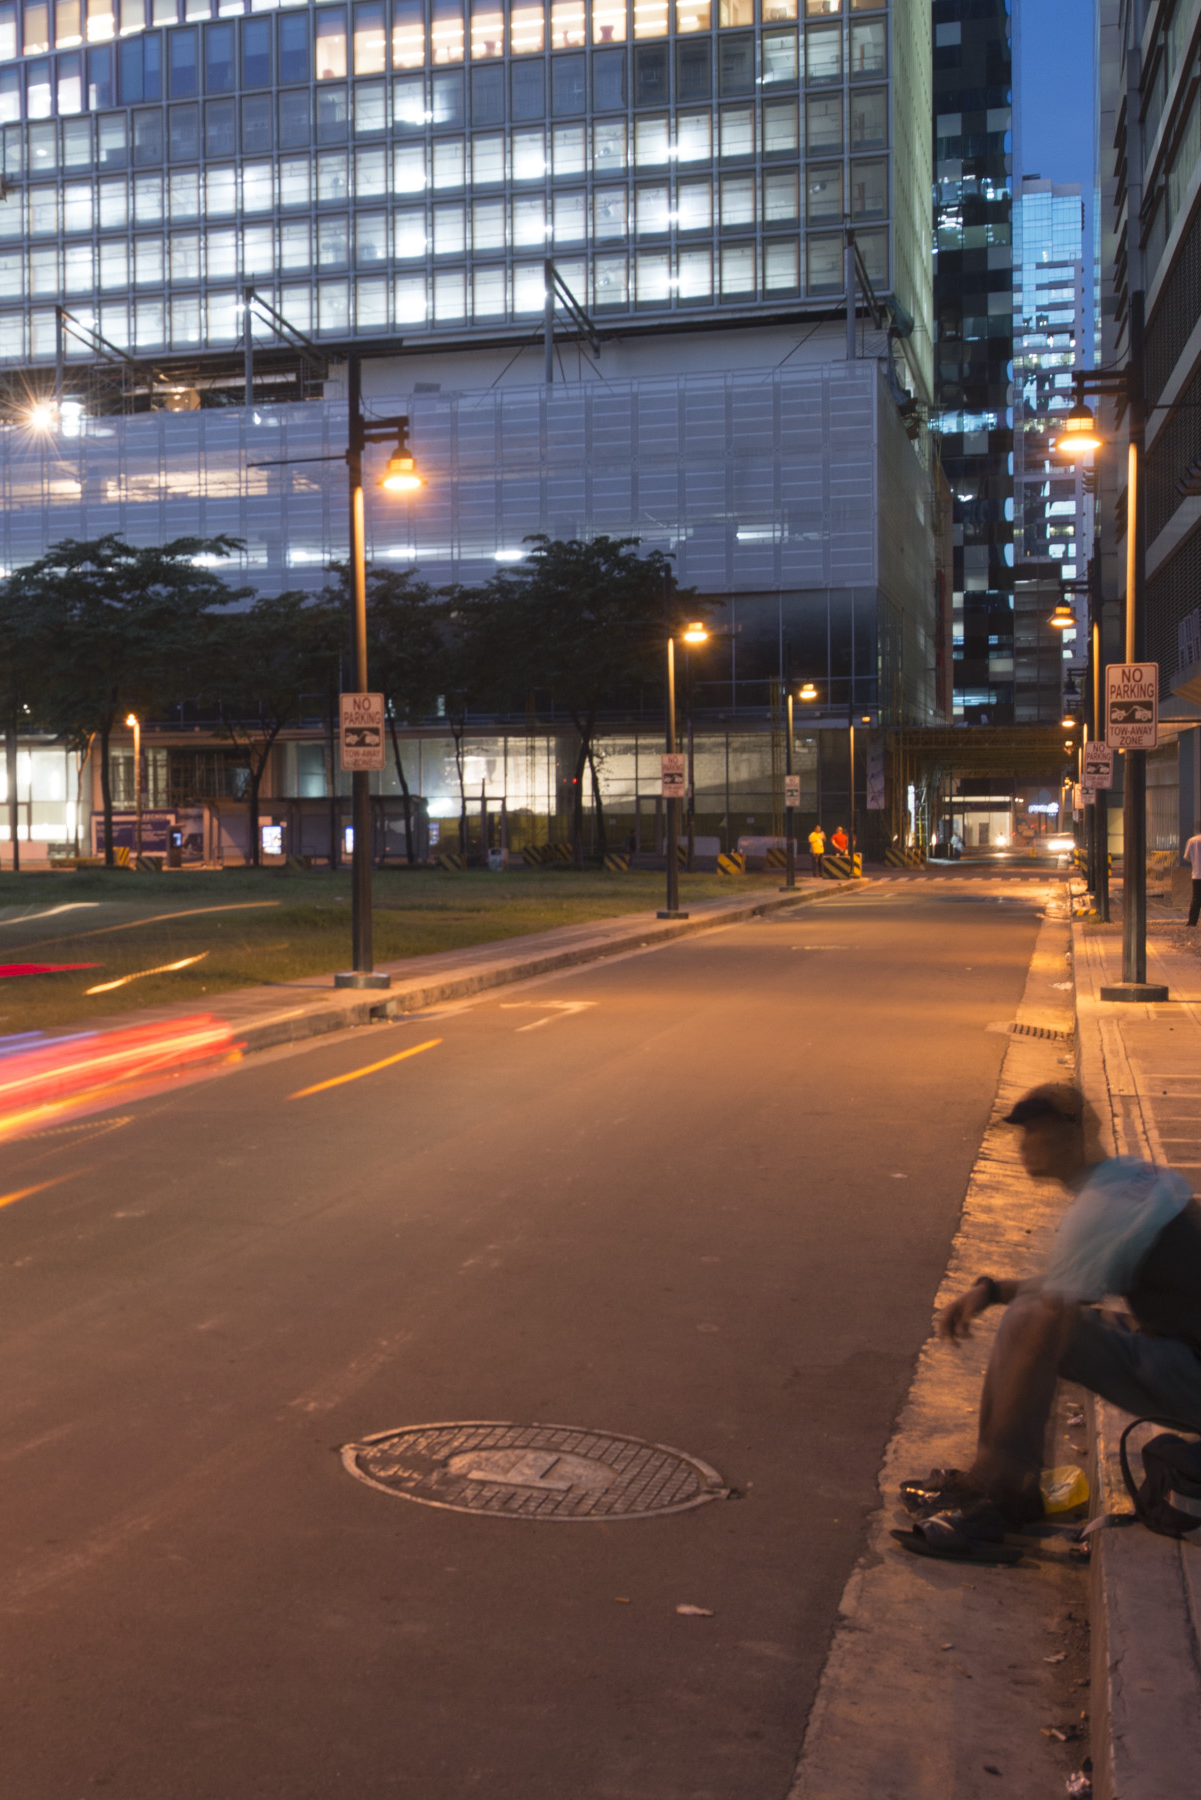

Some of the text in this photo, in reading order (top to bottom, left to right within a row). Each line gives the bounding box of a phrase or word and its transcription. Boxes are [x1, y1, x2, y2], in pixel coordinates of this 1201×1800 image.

[1121, 668, 1143, 683] NO
[1110, 683, 1154, 699] PARKING
[353, 697, 371, 711] NO
[343, 712, 381, 725] PARKING
[1110, 726, 1153, 736] TOW-AWAY
[1120, 736, 1144, 746] ZONE
[1093, 744, 1105, 753] NO
[1087, 752, 1111, 761] PARKING
